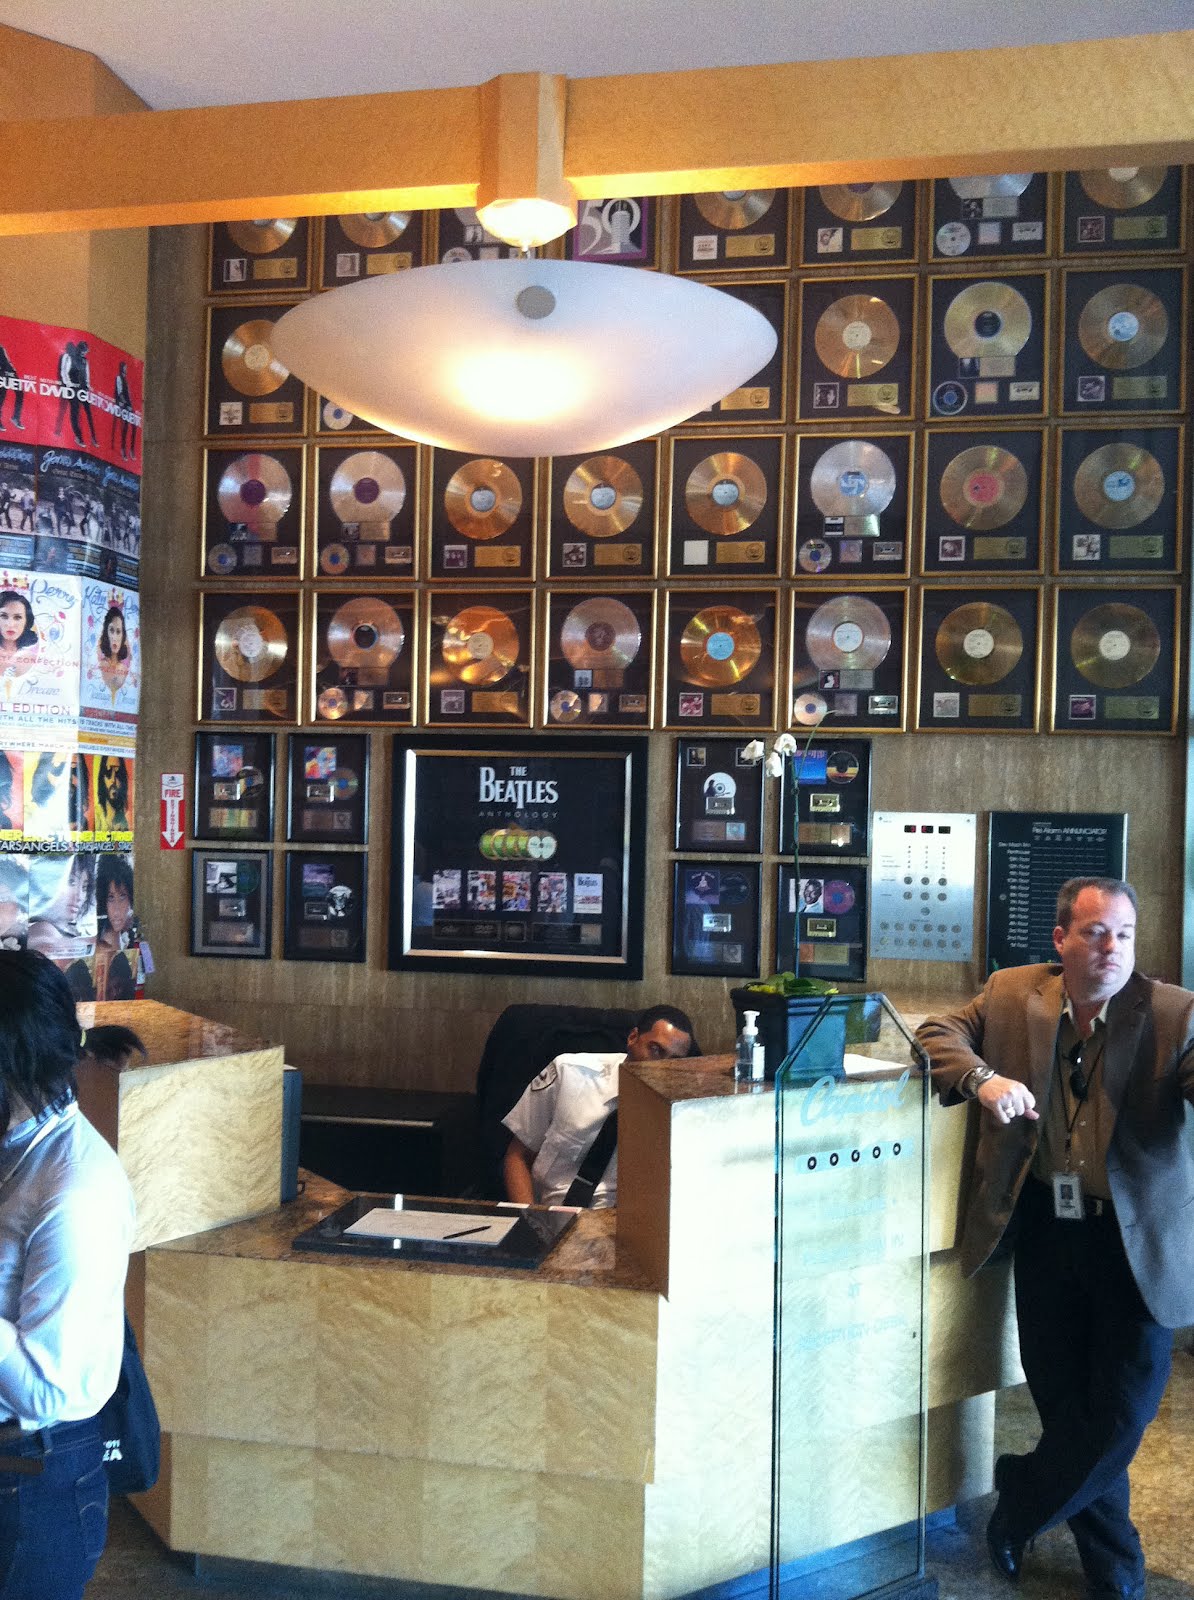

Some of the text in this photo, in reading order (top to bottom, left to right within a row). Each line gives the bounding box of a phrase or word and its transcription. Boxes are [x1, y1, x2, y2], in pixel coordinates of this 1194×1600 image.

[40, 382, 75, 400] DAVID
[16, 656, 79, 667] CONFECTION
[13, 702, 70, 715] EDITION
[509, 766, 528, 776] THE
[164, 788, 182, 798] FIRE
[479, 766, 559, 809] BEATLES
[478, 811, 558, 819] ANTHOLOGY
[22, 841, 67, 852] ANGELS
